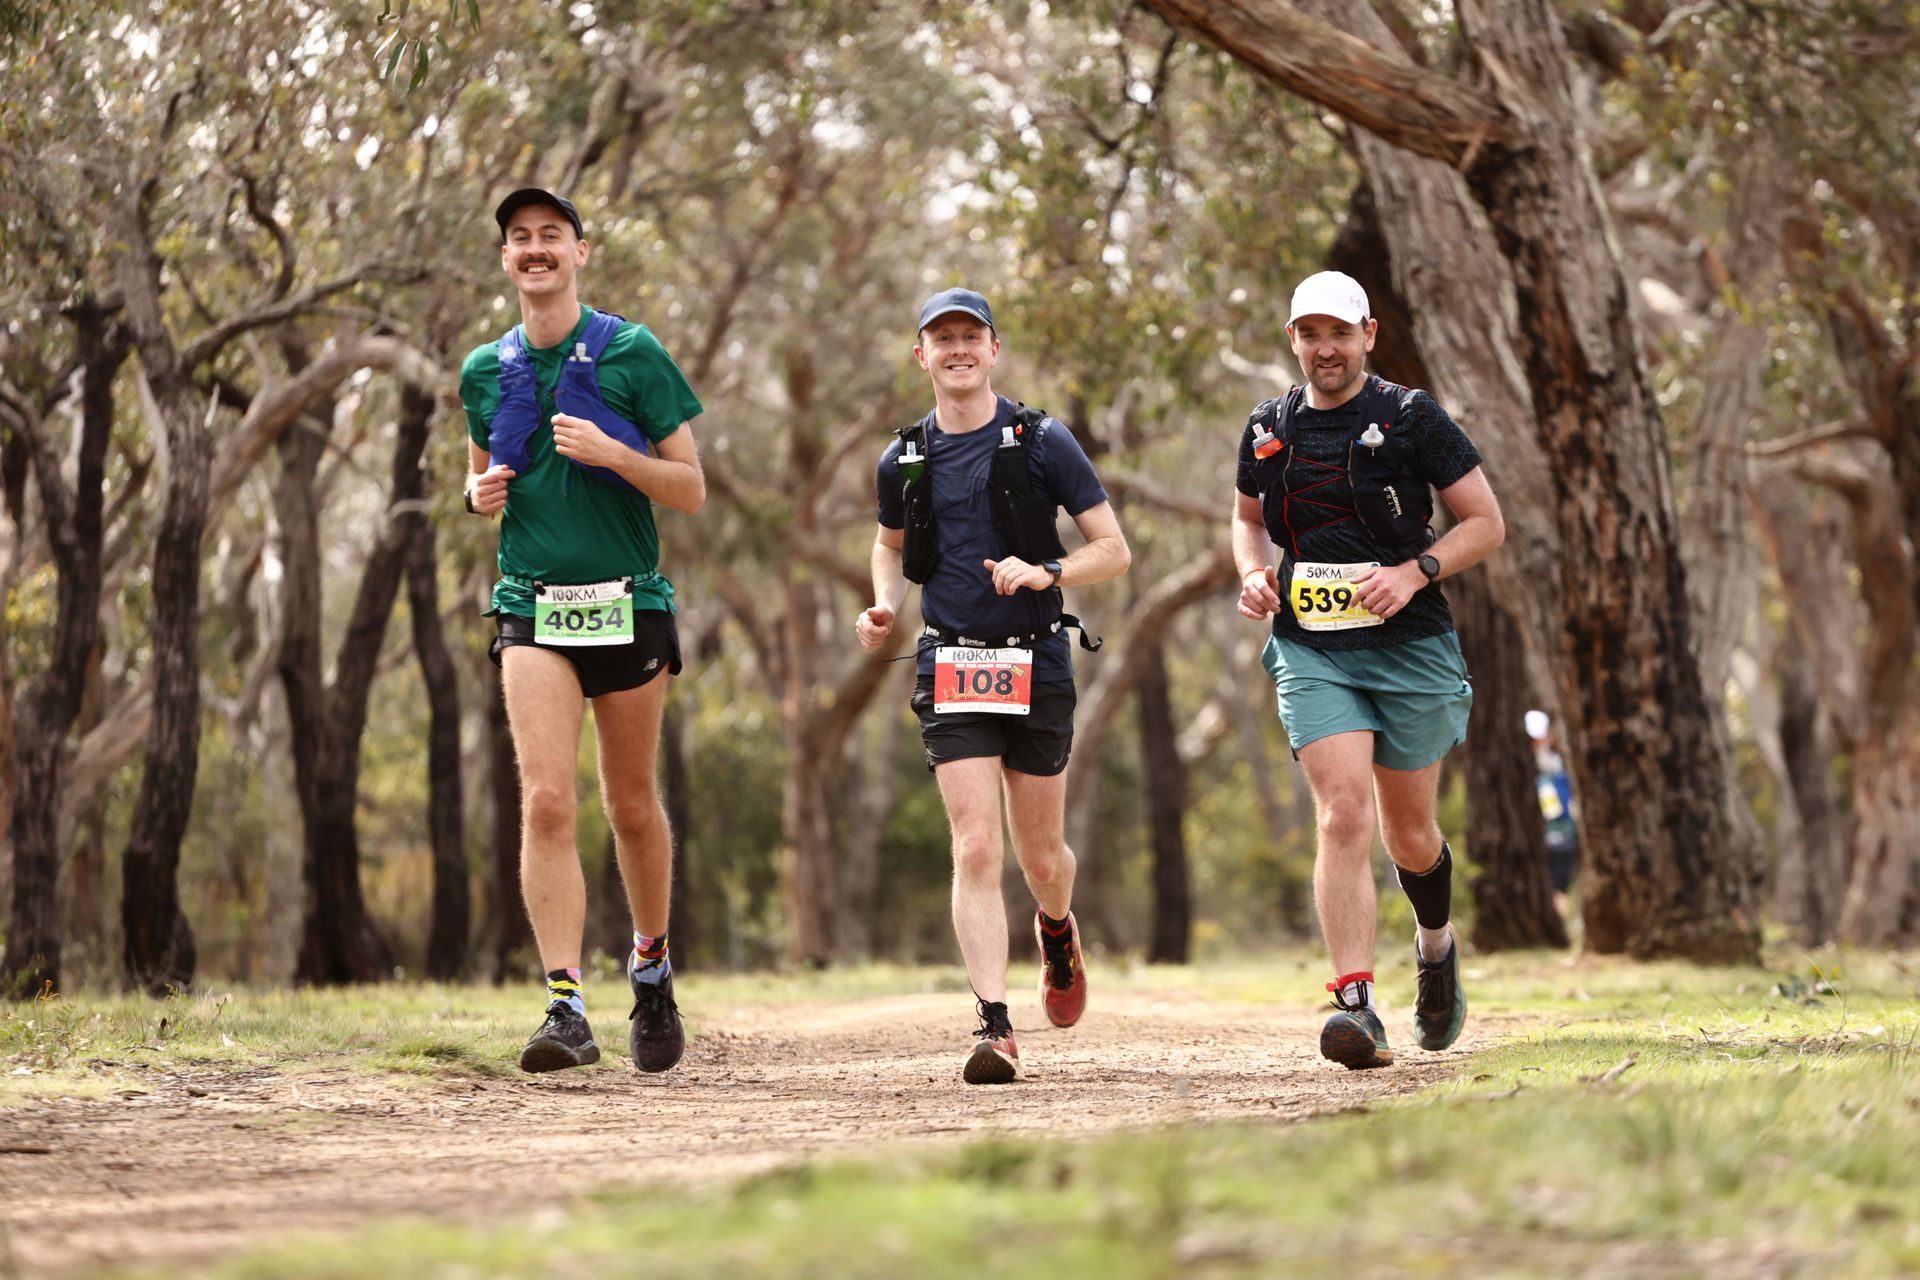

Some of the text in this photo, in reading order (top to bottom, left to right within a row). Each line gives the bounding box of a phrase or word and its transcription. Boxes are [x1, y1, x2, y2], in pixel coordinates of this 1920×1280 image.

[1387, 485, 1402, 515] SALOMON
[1306, 566, 1342, 579] 50KM
[552, 588, 597, 602] 100KM
[1299, 587, 1359, 612] 539
[544, 607, 624, 631] 4054
[952, 649, 997, 661] 100KM
[955, 669, 1013, 695] 108
